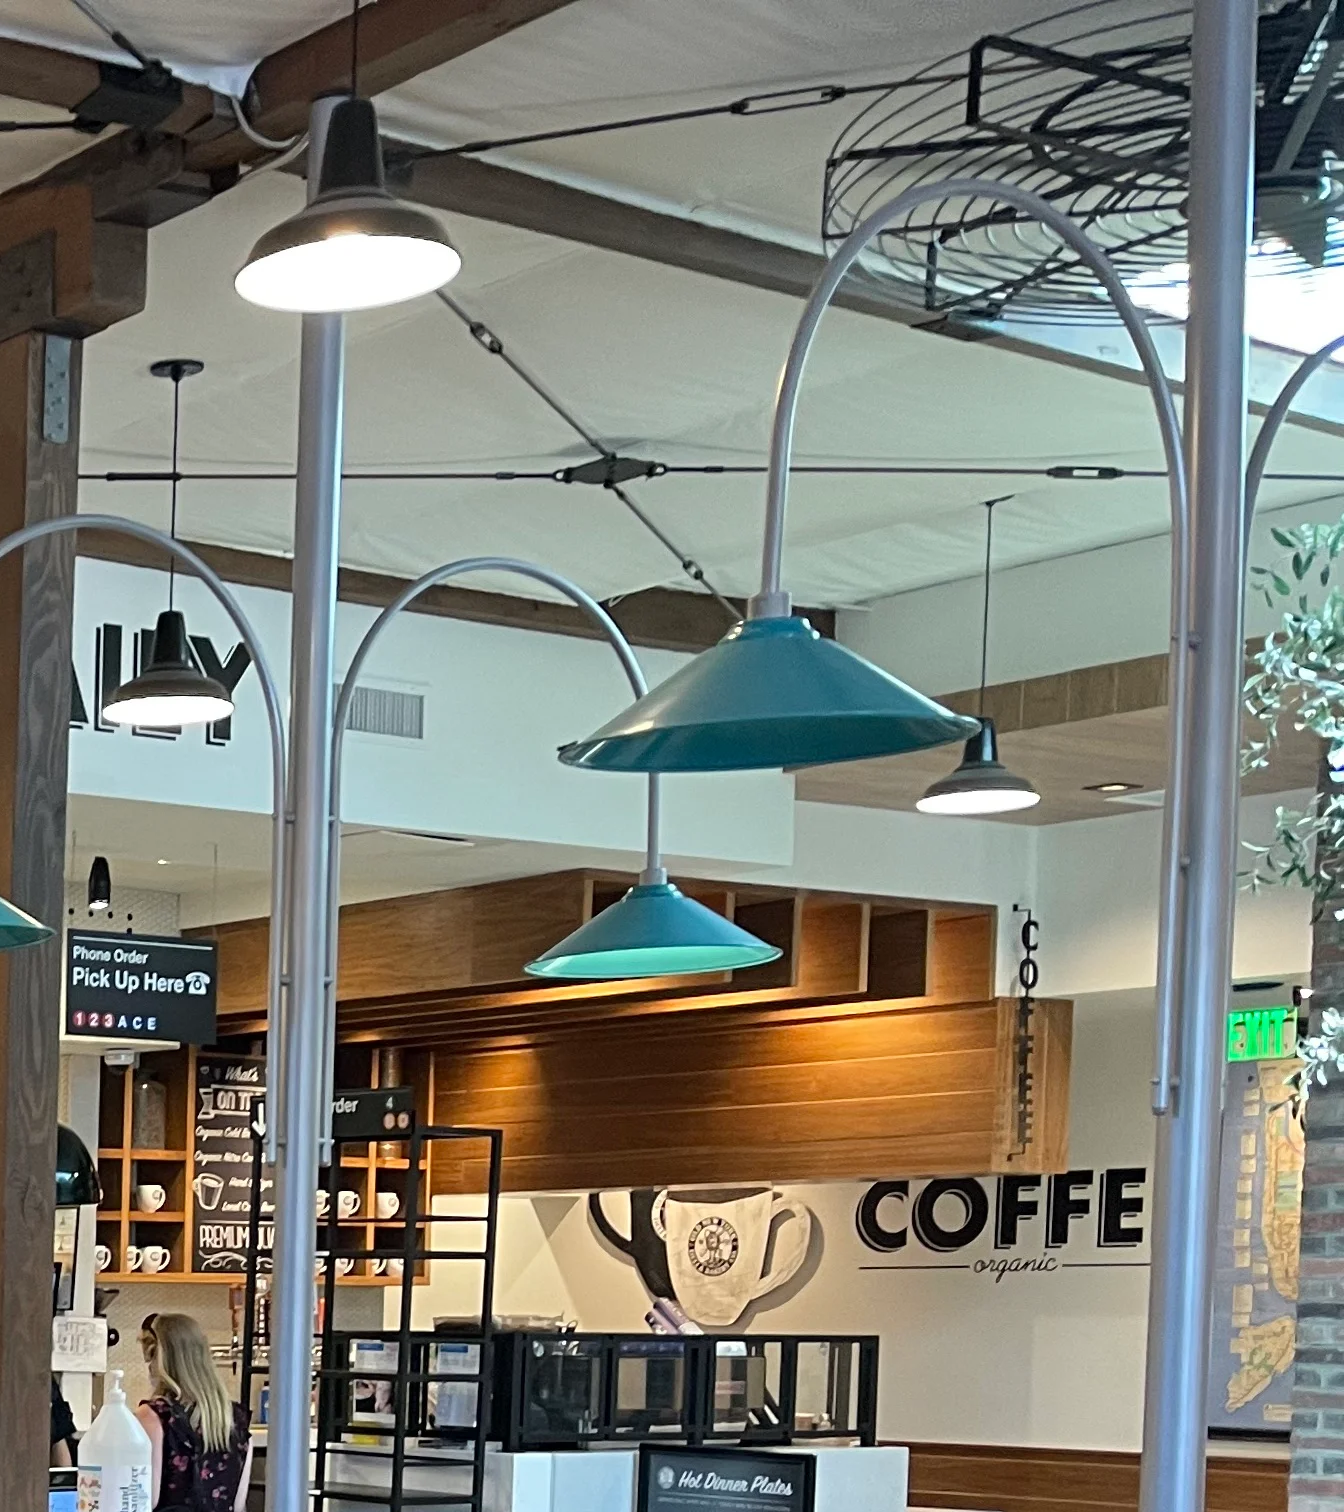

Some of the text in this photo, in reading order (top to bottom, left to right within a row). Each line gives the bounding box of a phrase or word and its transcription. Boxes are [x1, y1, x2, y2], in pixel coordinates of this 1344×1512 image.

[73, 945, 149, 964] Phone Order
[73, 966, 185, 994] Pick Up Here
[117, 1015, 128, 1028] A
[132, 1016, 143, 1030] C
[147, 1017, 157, 1030] E
[1018, 919, 1039, 1144] COFFEE
[1228, 1010, 1289, 1060] EXIT
[332, 1097, 359, 1114] rder
[855, 1168, 1147, 1252] COFFE
[199, 1225, 249, 1249] PREMIUM
[973, 1252, 1059, 1283] organic
[678, 1470, 793, 1495] Hot Dinner Plates
